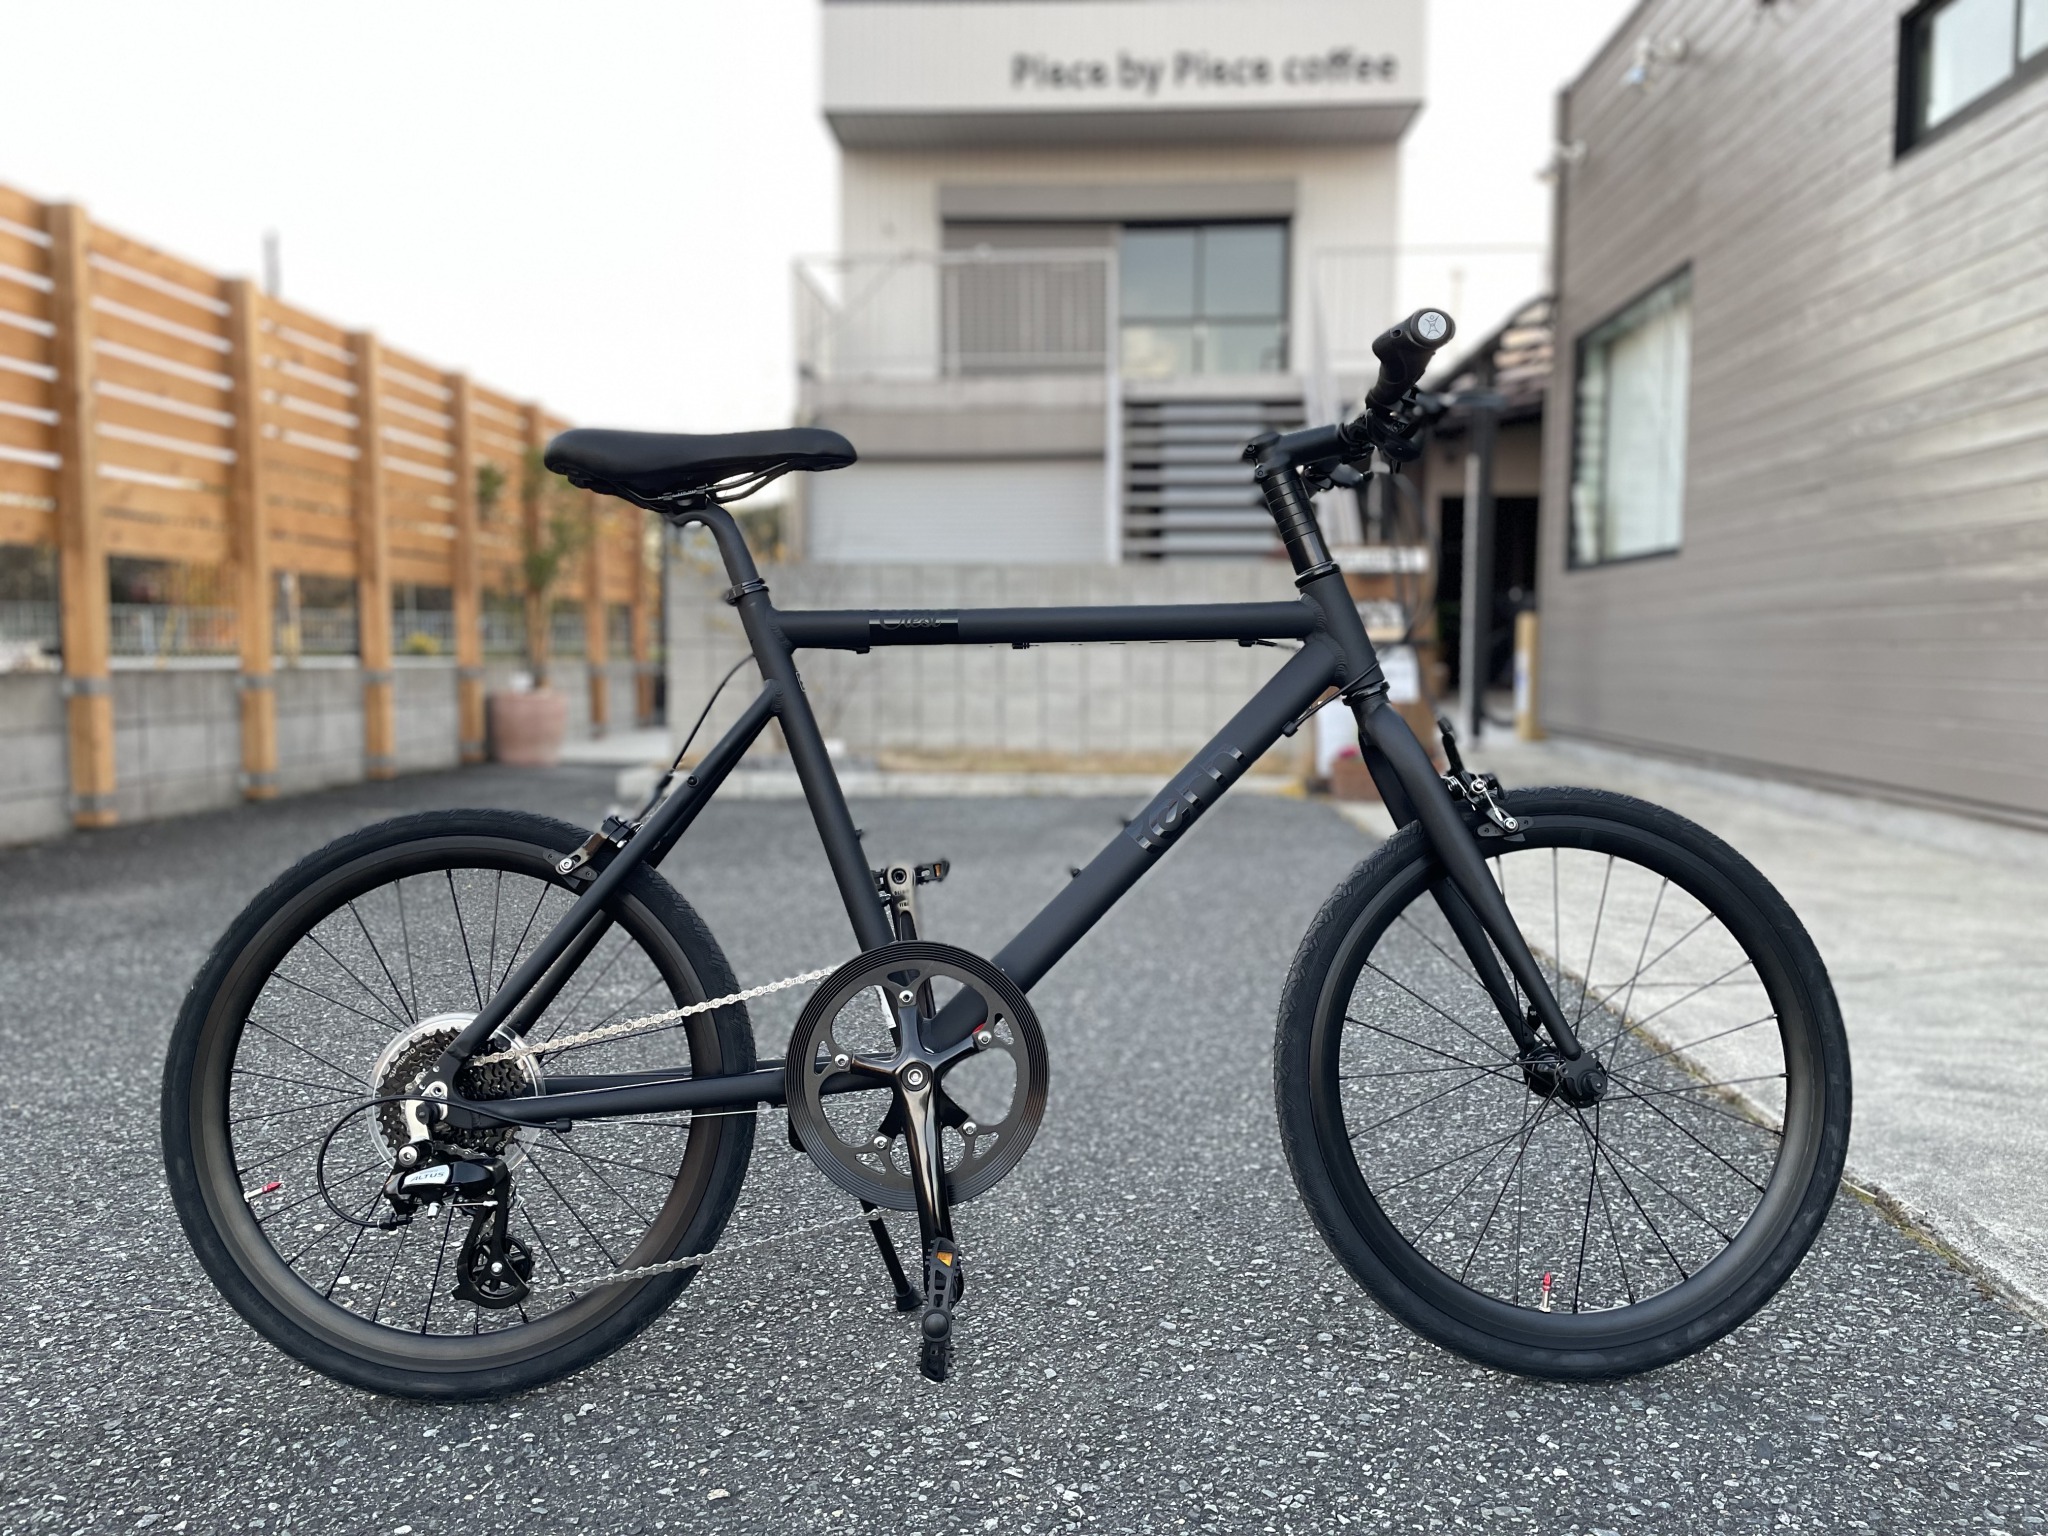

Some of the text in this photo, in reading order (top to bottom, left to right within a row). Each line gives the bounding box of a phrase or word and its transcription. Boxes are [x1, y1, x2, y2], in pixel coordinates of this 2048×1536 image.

[1012, 48, 1397, 95] Piece by Piece coffee
[410, 1172, 445, 1182] ALTUS
